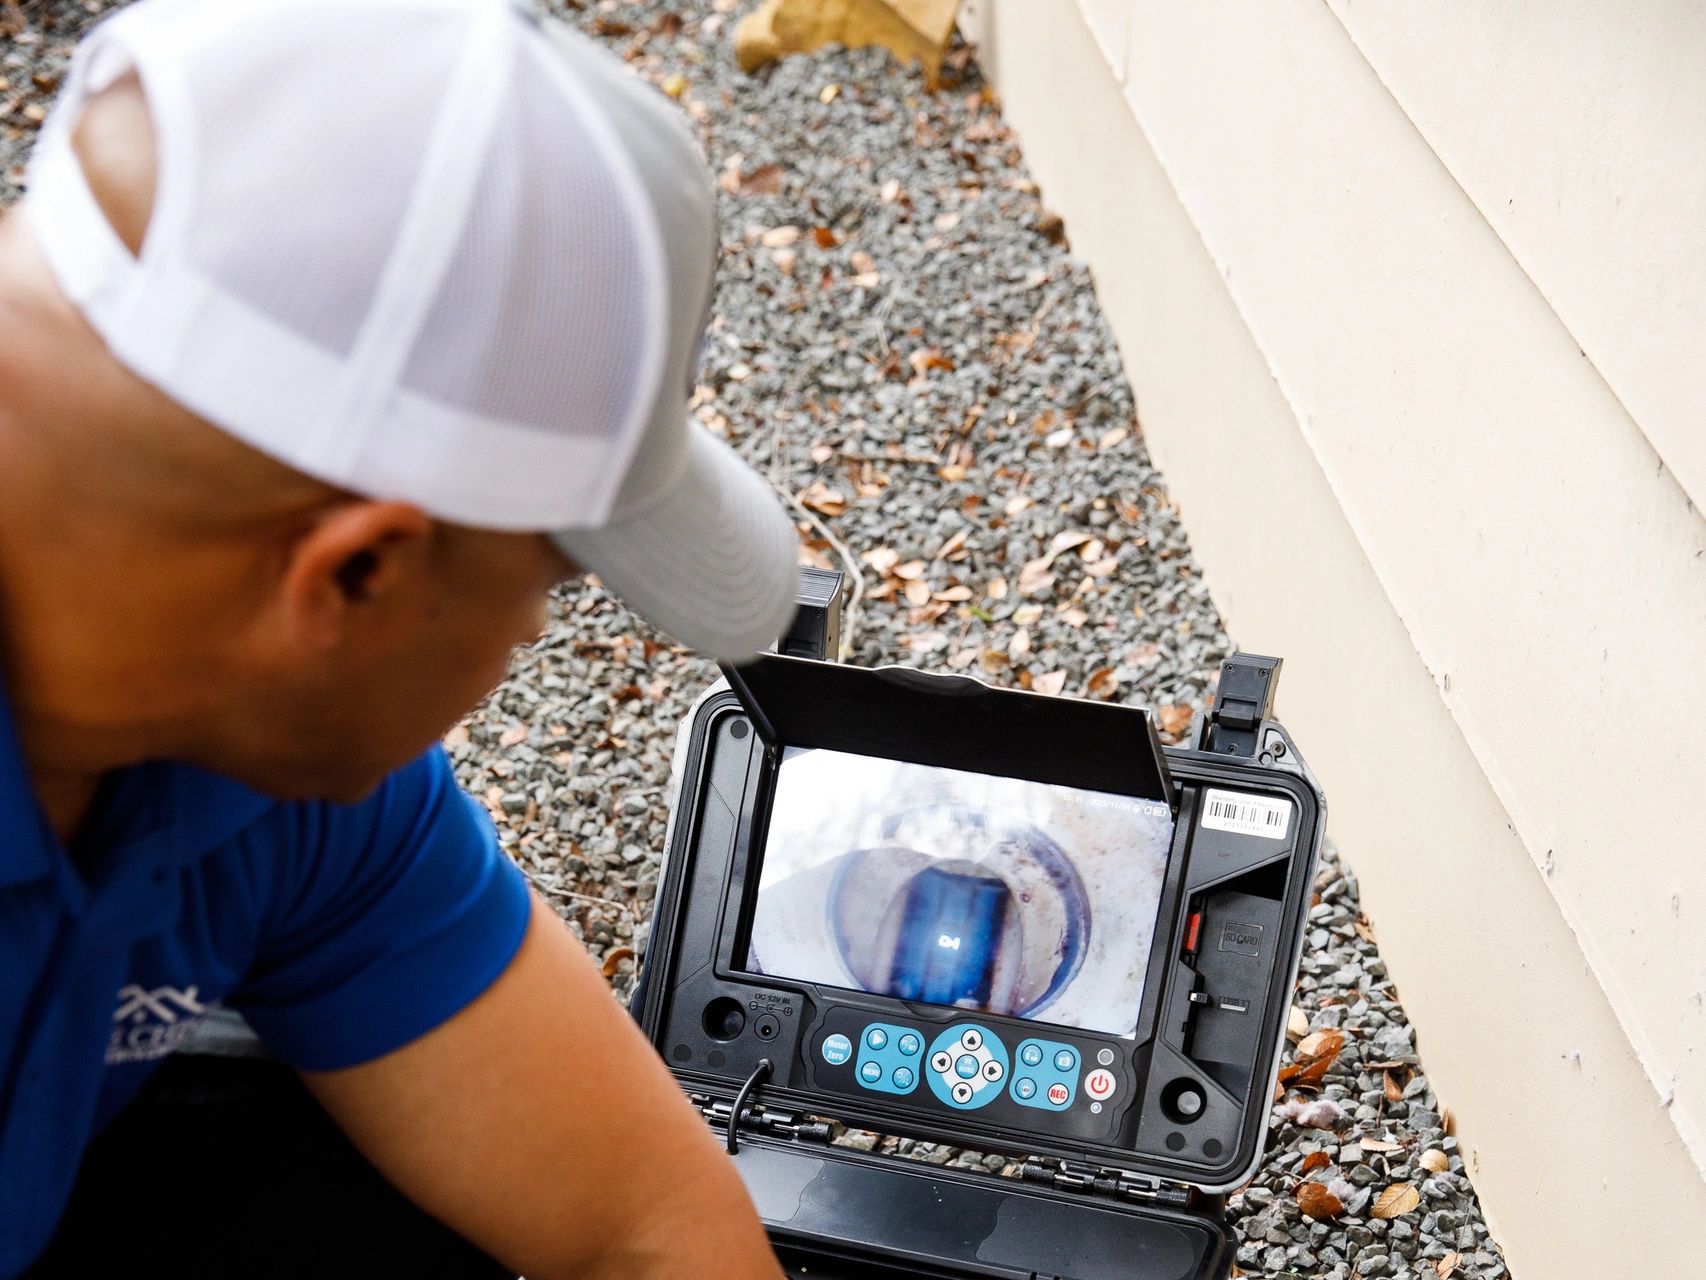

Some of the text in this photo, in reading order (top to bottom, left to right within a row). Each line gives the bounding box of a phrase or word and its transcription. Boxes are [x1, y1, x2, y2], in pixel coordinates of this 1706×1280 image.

[754, 993, 766, 1001] DC
[767, 995, 781, 1003] 12V
[827, 1050, 844, 1061] Zero
[863, 1068, 880, 1077] MENU
[958, 1065, 975, 1073] HOME
[1050, 1088, 1066, 1100] REC
